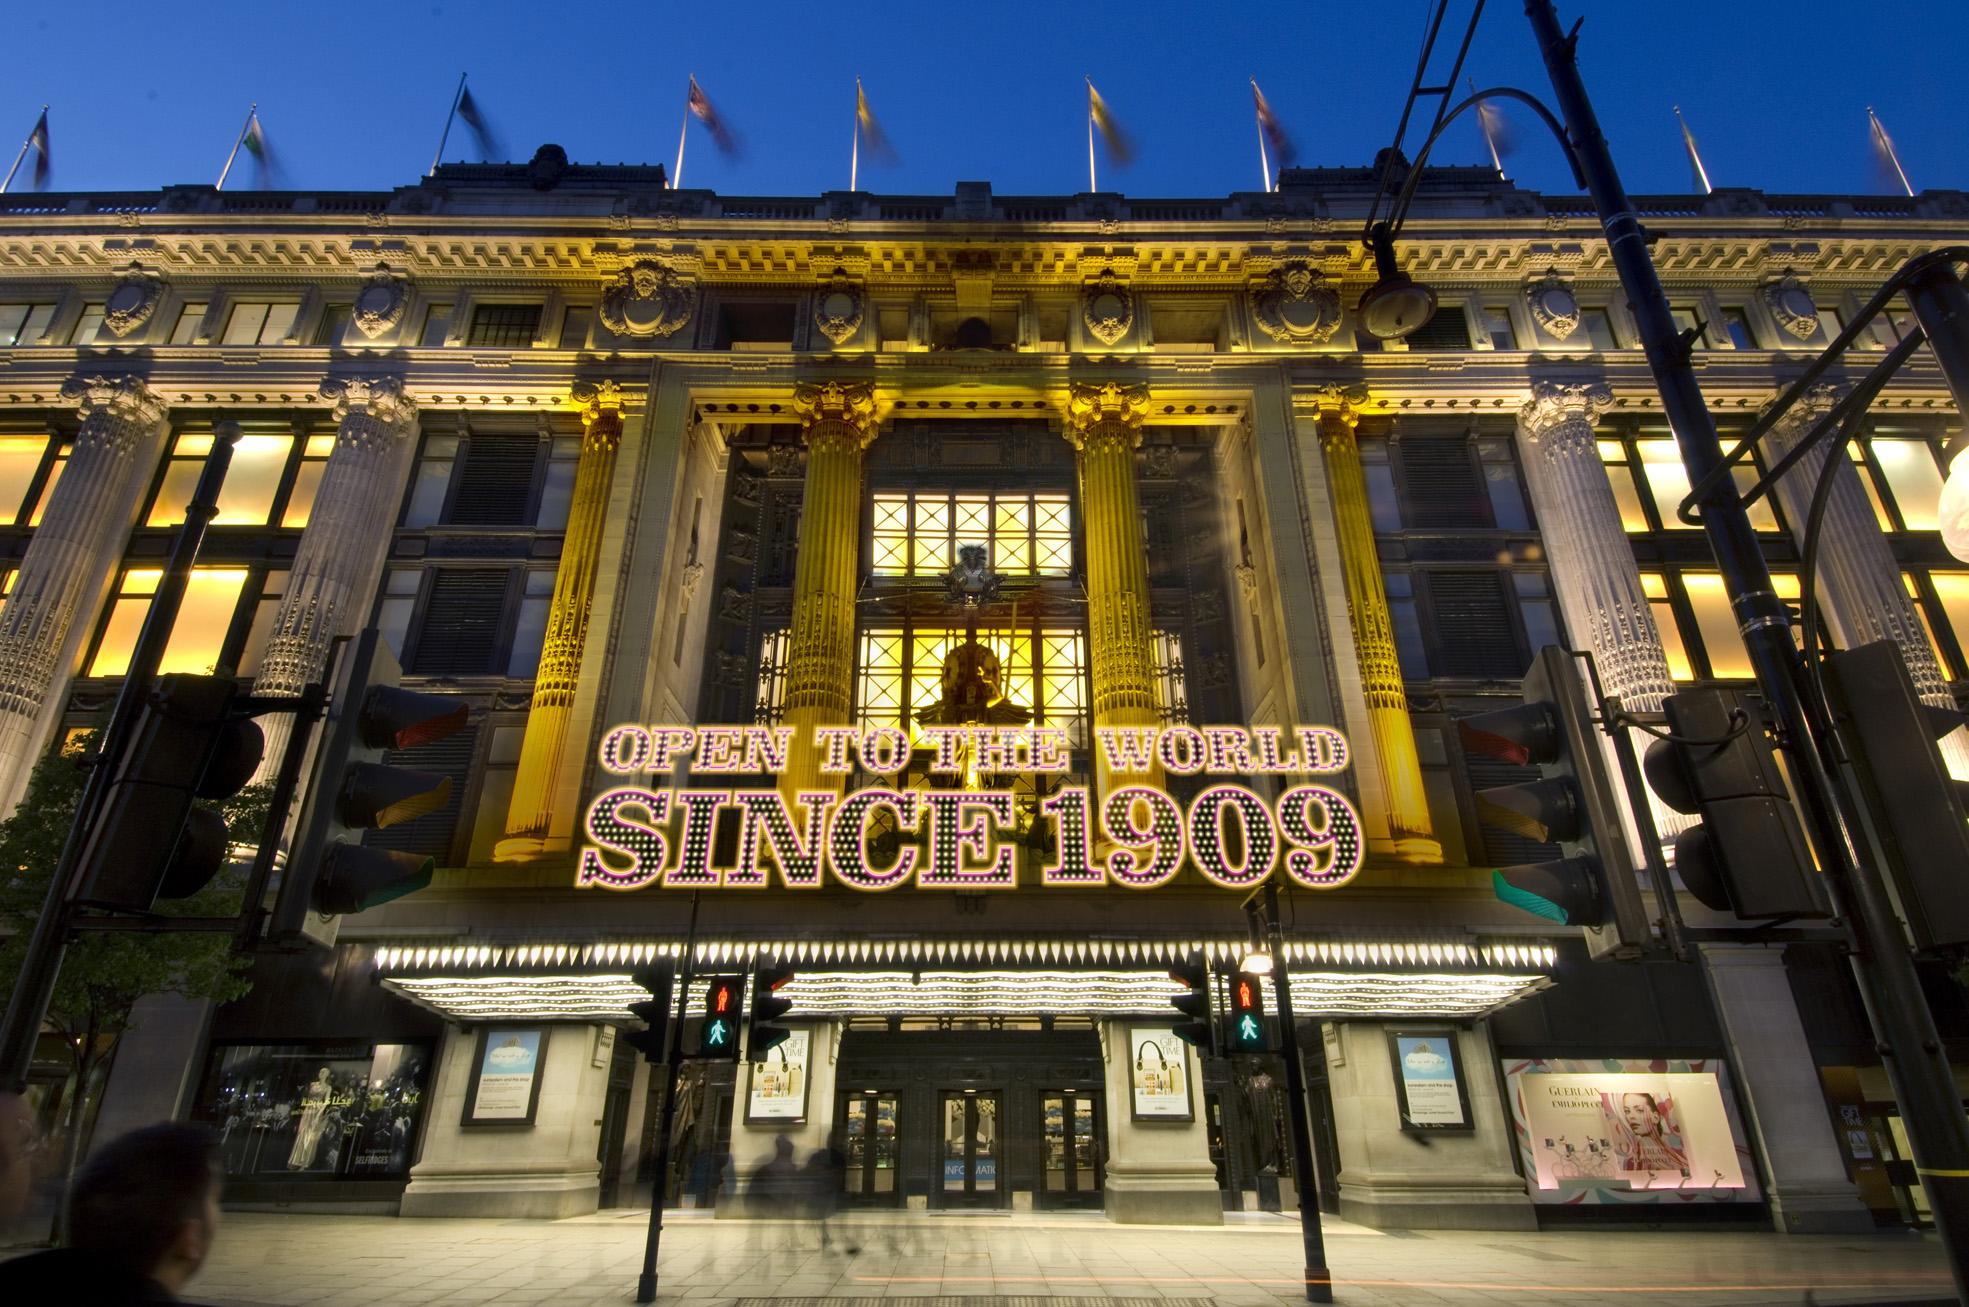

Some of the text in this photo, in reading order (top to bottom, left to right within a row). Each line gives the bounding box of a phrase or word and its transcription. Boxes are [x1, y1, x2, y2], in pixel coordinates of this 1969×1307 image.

[602, 725, 1349, 774] OPEN TO THE WORLD
[575, 785, 1365, 889] SINCE 1909
[784, 1039, 804, 1049] GIFT
[1160, 1038, 1180, 1047] GIFT
[785, 1048, 804, 1057] TIME
[1161, 1047, 1181, 1055] TIME
[1548, 1085, 1601, 1096] GUERLAIN
[355, 1155, 388, 1165] SELFRIDGES
[945, 1165, 996, 1175] INFOMATI
